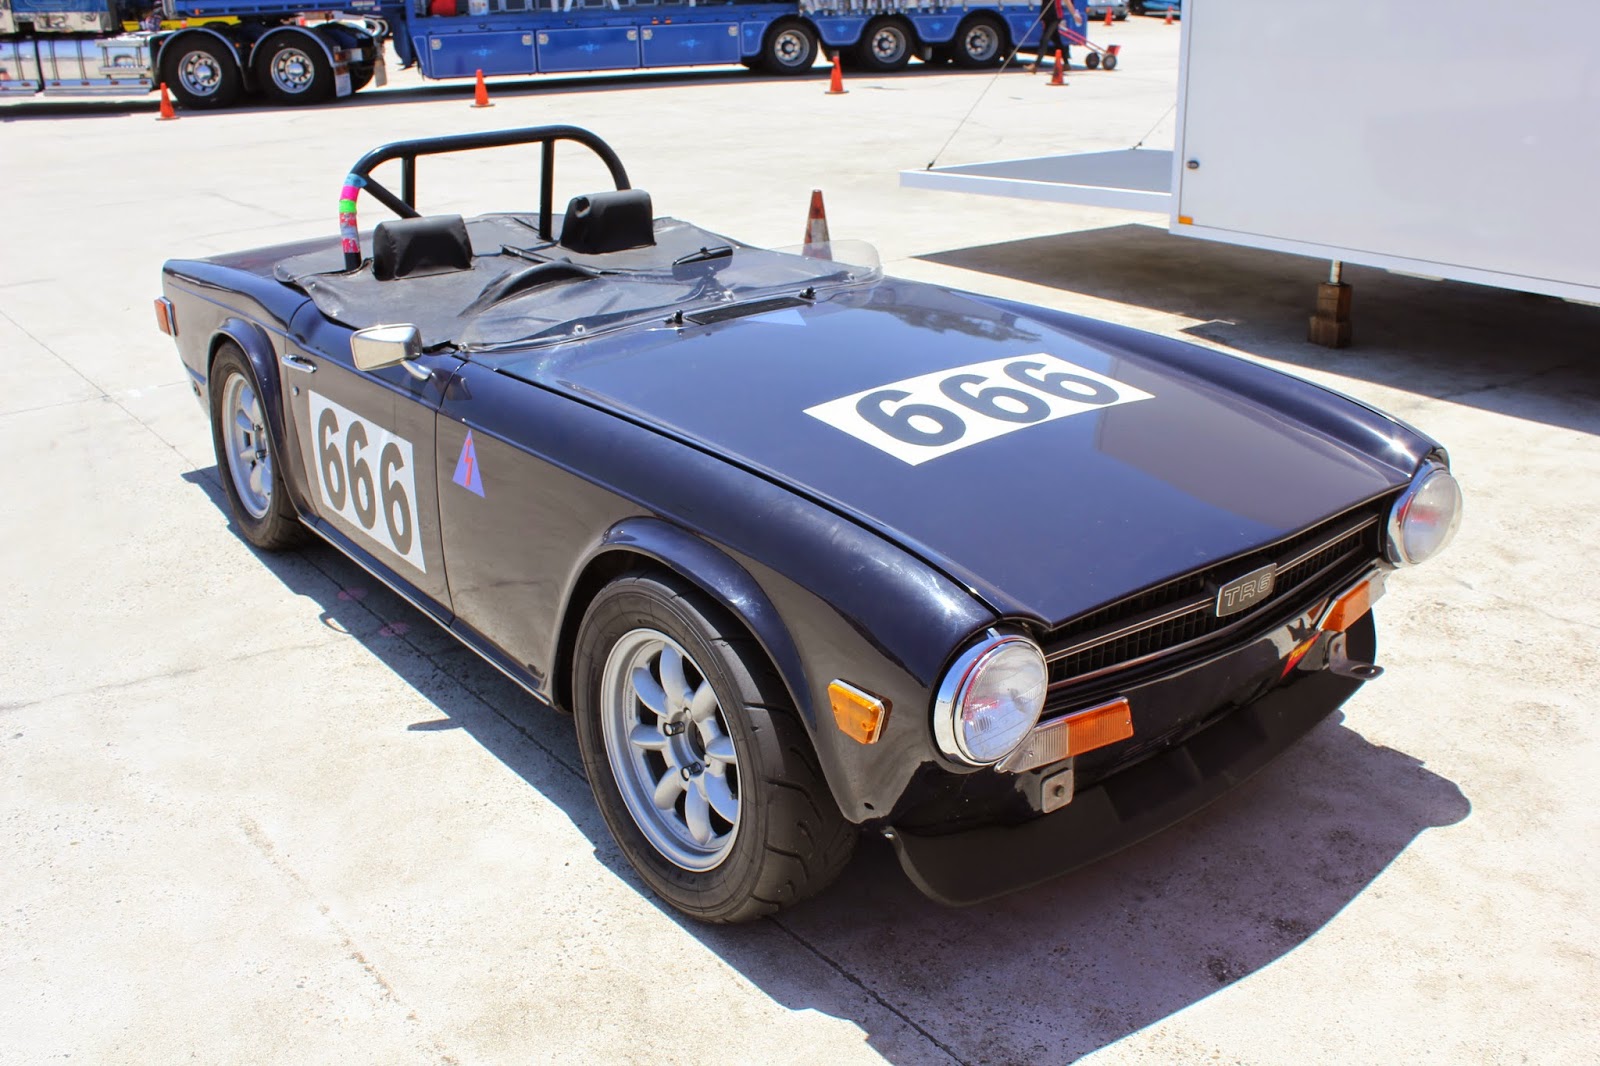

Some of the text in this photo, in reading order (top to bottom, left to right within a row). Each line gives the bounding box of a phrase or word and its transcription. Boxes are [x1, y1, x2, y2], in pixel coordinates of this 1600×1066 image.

[856, 361, 1120, 446] 666
[318, 407, 412, 555] 666
[1224, 572, 1272, 607] TR6
